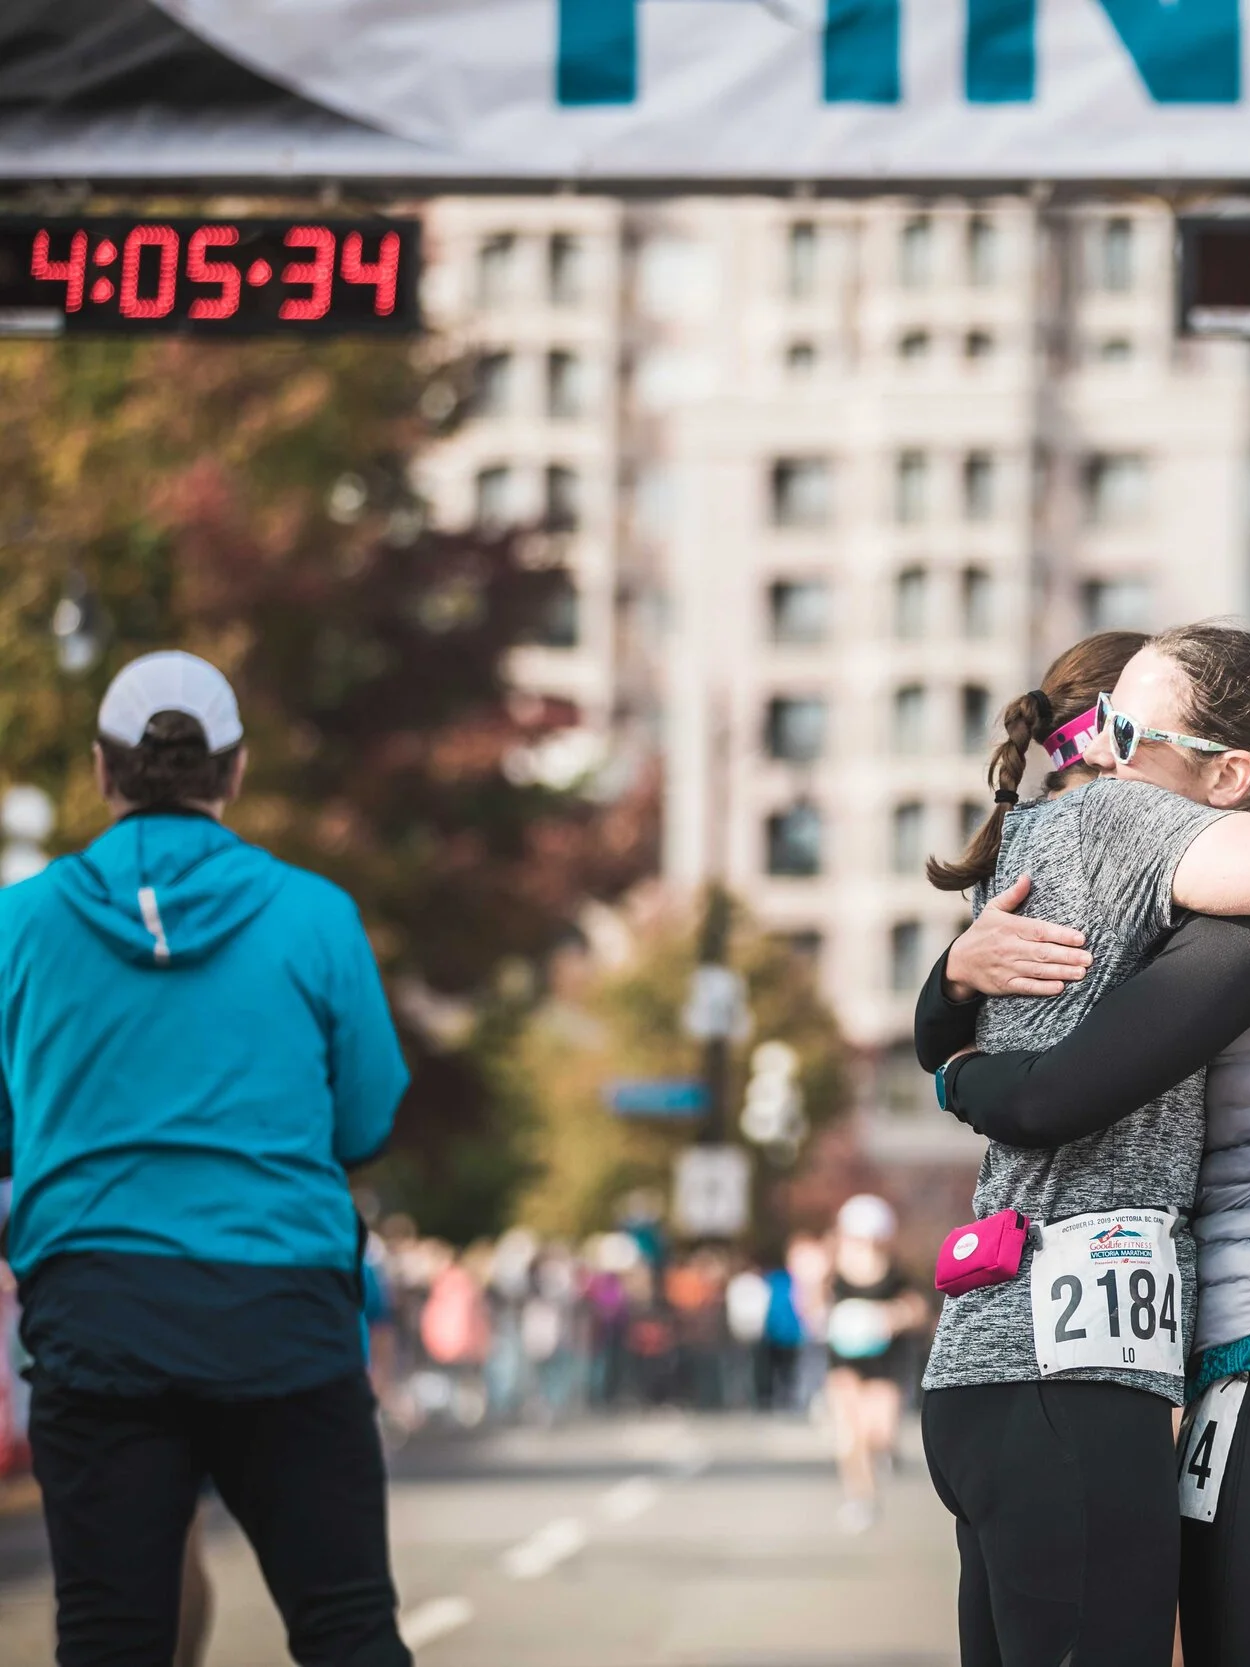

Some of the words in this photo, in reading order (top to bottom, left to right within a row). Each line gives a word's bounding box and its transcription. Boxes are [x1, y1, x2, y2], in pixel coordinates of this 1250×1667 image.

[1061, 1221, 1088, 1234] OCTOBER
[1097, 1217, 1112, 1225] 2019
[1123, 1241, 1152, 1249] FITNESS
[1091, 1250, 1119, 1258] VICTORIA
[1051, 1268, 1177, 1343] 2184
[1122, 1347, 1135, 1363] LO
[1188, 1420, 1218, 1490] 4
